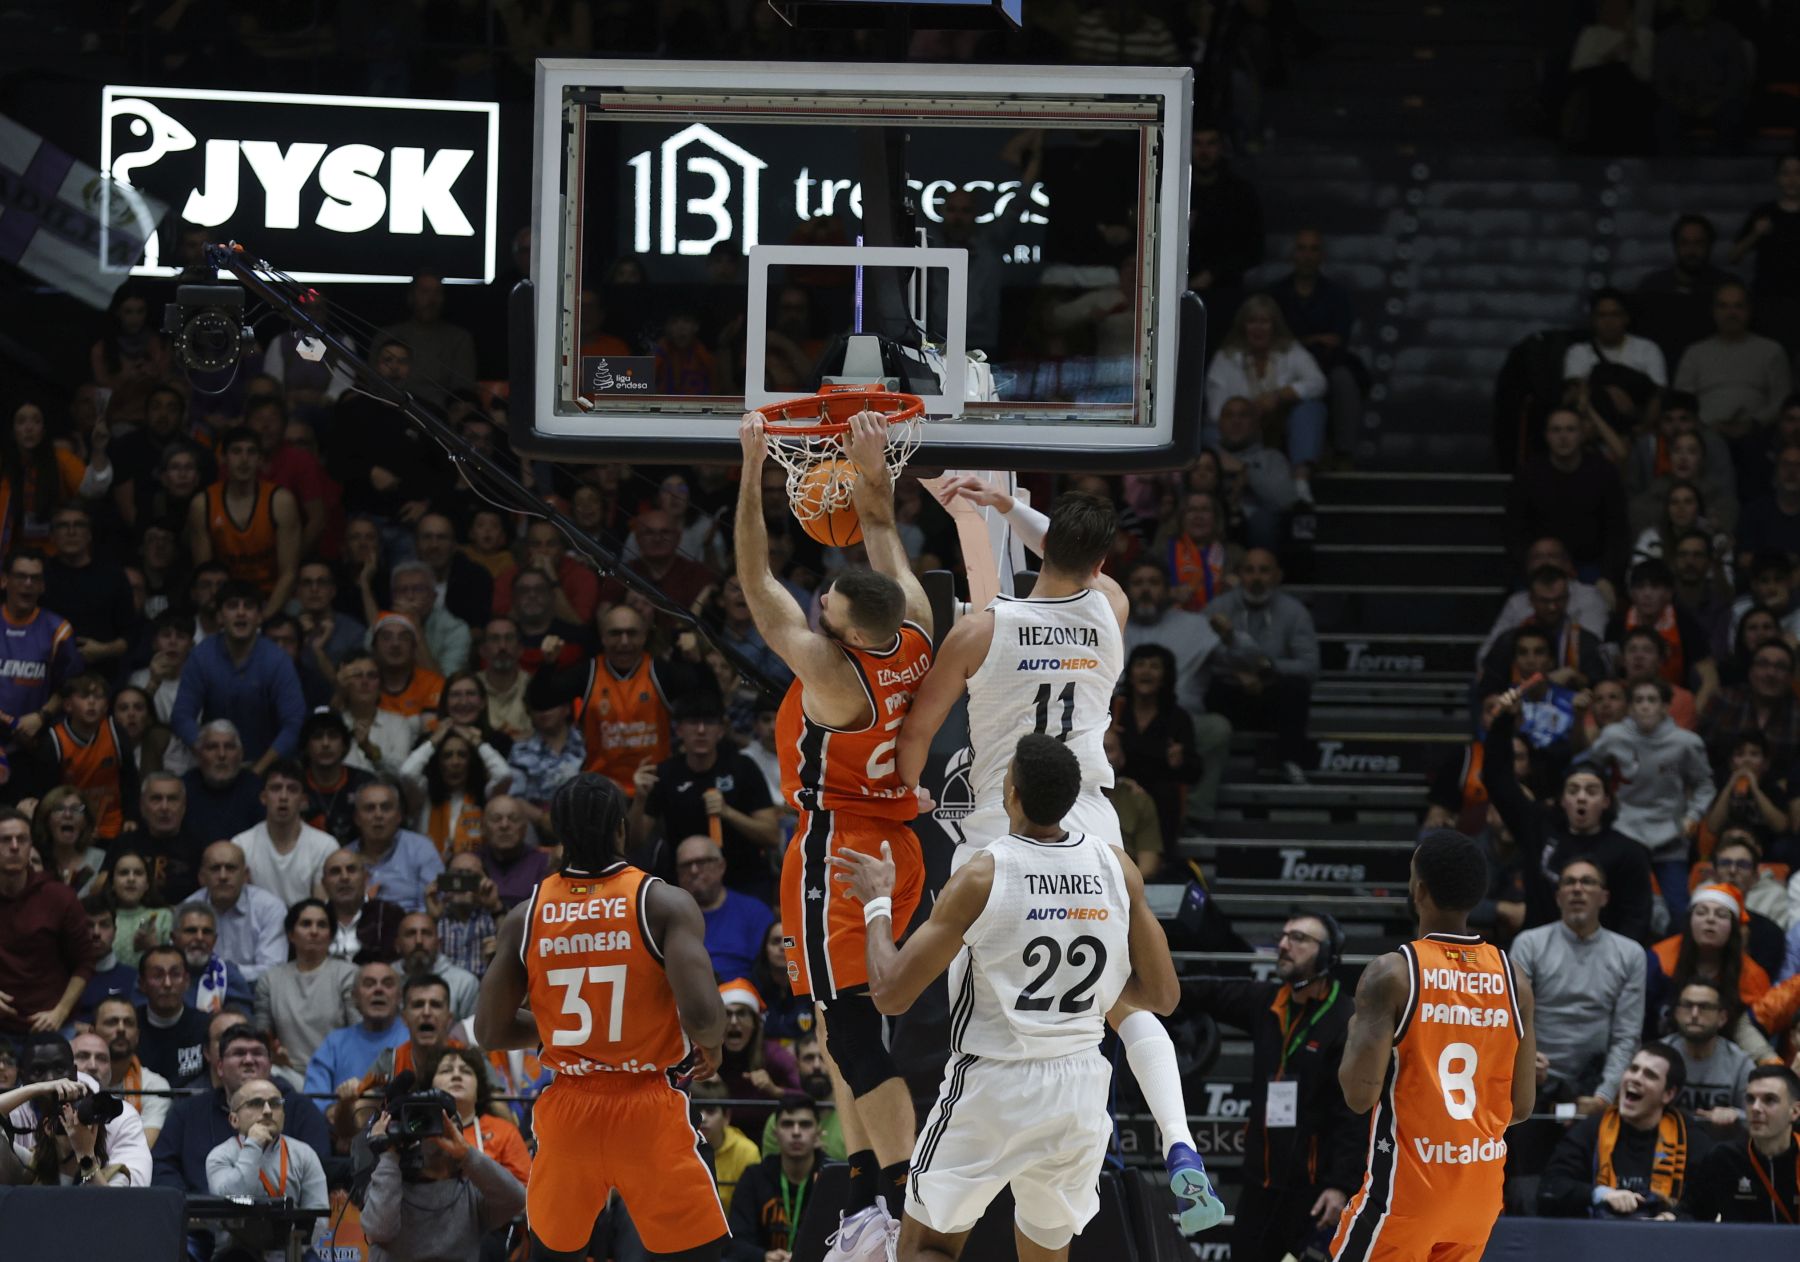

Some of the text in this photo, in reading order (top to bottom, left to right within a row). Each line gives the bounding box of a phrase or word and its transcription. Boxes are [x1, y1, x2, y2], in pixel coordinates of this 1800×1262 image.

[182, 139, 474, 236] JYSK
[1018, 627, 1099, 647] HEZONJA
[1017, 658, 1098, 671] AUTOHERO
[1344, 643, 1425, 671] Torres
[1032, 681, 1076, 742] 11
[1317, 742, 1401, 772] Torres
[939, 811, 972, 819] VALEN
[1279, 849, 1367, 881] Torres
[1024, 874, 1103, 894] TAVARES
[542, 898, 627, 924] OJELEYE
[1026, 908, 1109, 920] AUTOHERO
[539, 930, 632, 958] PAMESA
[1014, 935, 1108, 1013] 22
[1423, 968, 1505, 995] MONTERO
[547, 964, 628, 1046] 37
[1420, 1003, 1509, 1028] PAMESA
[1438, 1042, 1478, 1121] 8
[1204, 1083, 1252, 1117] Tor
[1677, 1088, 1732, 1111] ANS
